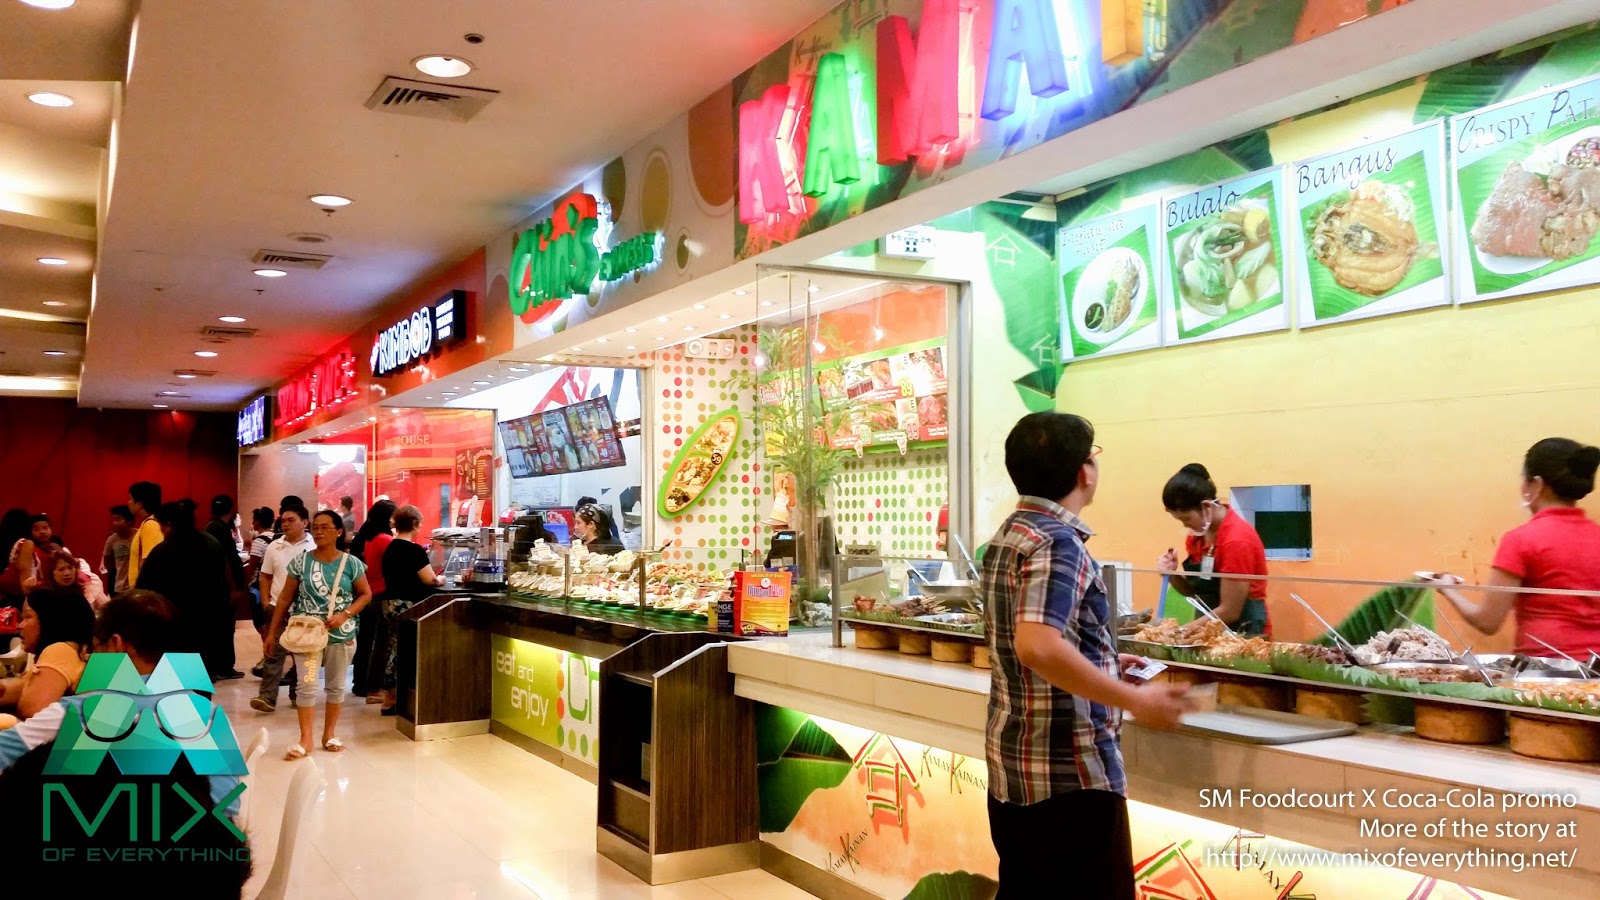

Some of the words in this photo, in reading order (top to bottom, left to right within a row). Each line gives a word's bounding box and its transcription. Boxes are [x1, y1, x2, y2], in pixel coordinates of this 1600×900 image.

[1547, 90, 1599, 129] PAT
[1296, 143, 1398, 194] Bangus
[1166, 185, 1241, 228] Bulalo
[379, 306, 432, 374] KIMBOB
[393, 434, 431, 446] OUSE
[496, 649, 516, 677] eat
[518, 665, 534, 683] and
[511, 685, 549, 727] enjoy
